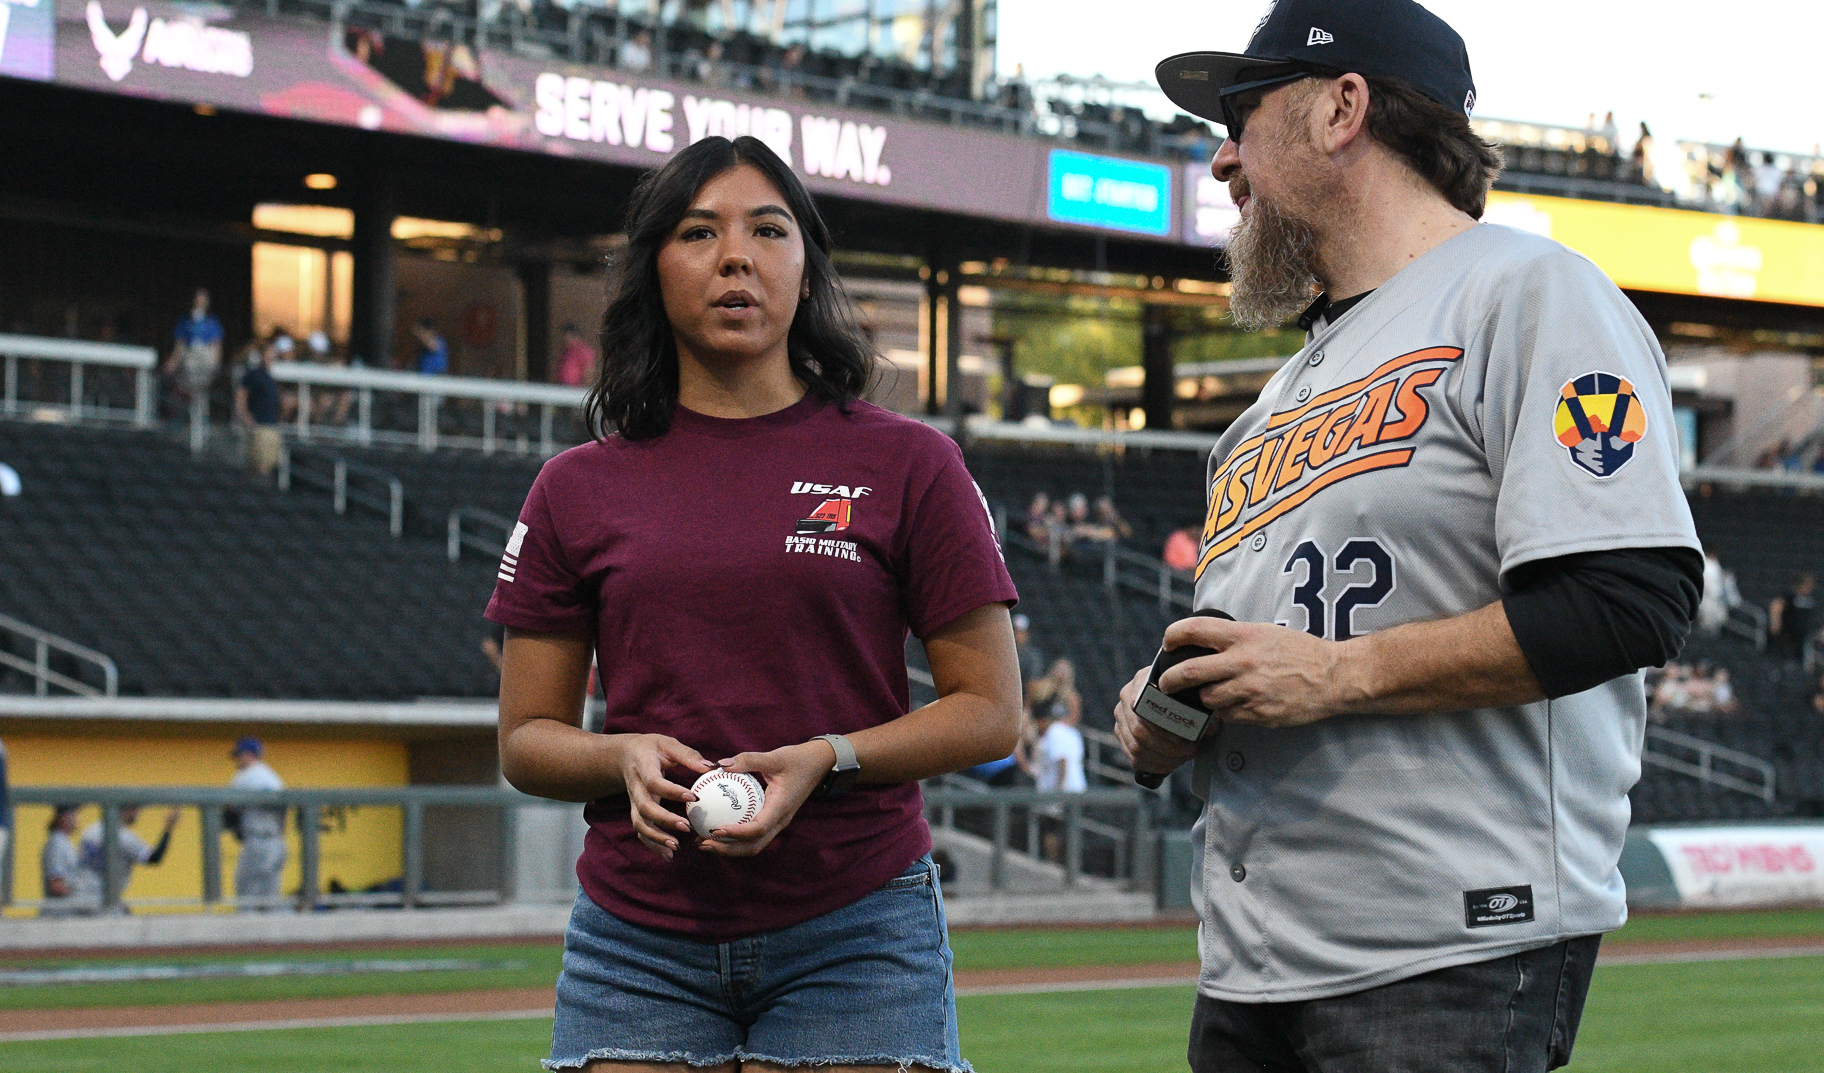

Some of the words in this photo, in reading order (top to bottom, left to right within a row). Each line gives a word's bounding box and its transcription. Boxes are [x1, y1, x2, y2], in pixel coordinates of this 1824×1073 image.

[535, 72, 674, 153] SERVE
[682, 95, 794, 168] YOUR
[801, 115, 891, 186] WAY.
[790, 481, 873, 498] USAF
[785, 535, 817, 545] BASIC
[818, 539, 858, 552] MILITARY
[1277, 537, 1396, 641] 32
[1146, 699, 1167, 713] red
[1169, 712, 1197, 727] rock
